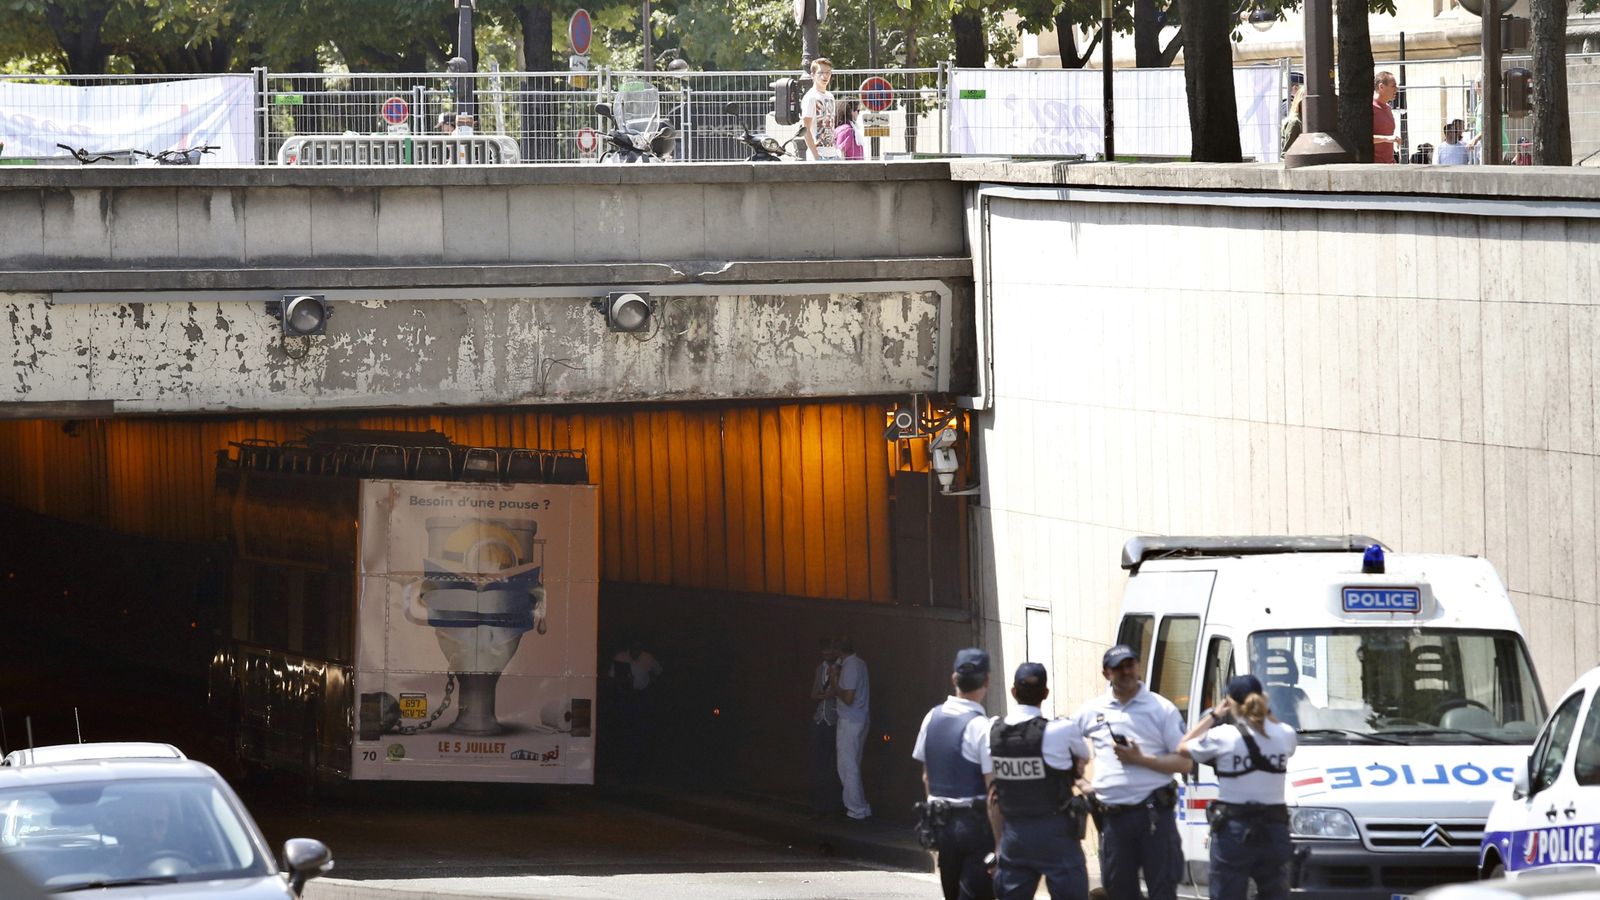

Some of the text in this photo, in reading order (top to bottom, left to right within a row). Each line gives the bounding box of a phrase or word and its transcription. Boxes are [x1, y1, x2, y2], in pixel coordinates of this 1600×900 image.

[409, 496, 453, 507] Besoin
[499, 500, 539, 511] pause
[1348, 593, 1415, 606] POLICE
[438, 741, 450, 752] LE
[465, 742, 506, 753] JUILLET
[362, 751, 377, 761] 70
[1233, 754, 1286, 770] POCE
[993, 760, 1041, 776] POLICE
[1538, 826, 1594, 864] POLICE
